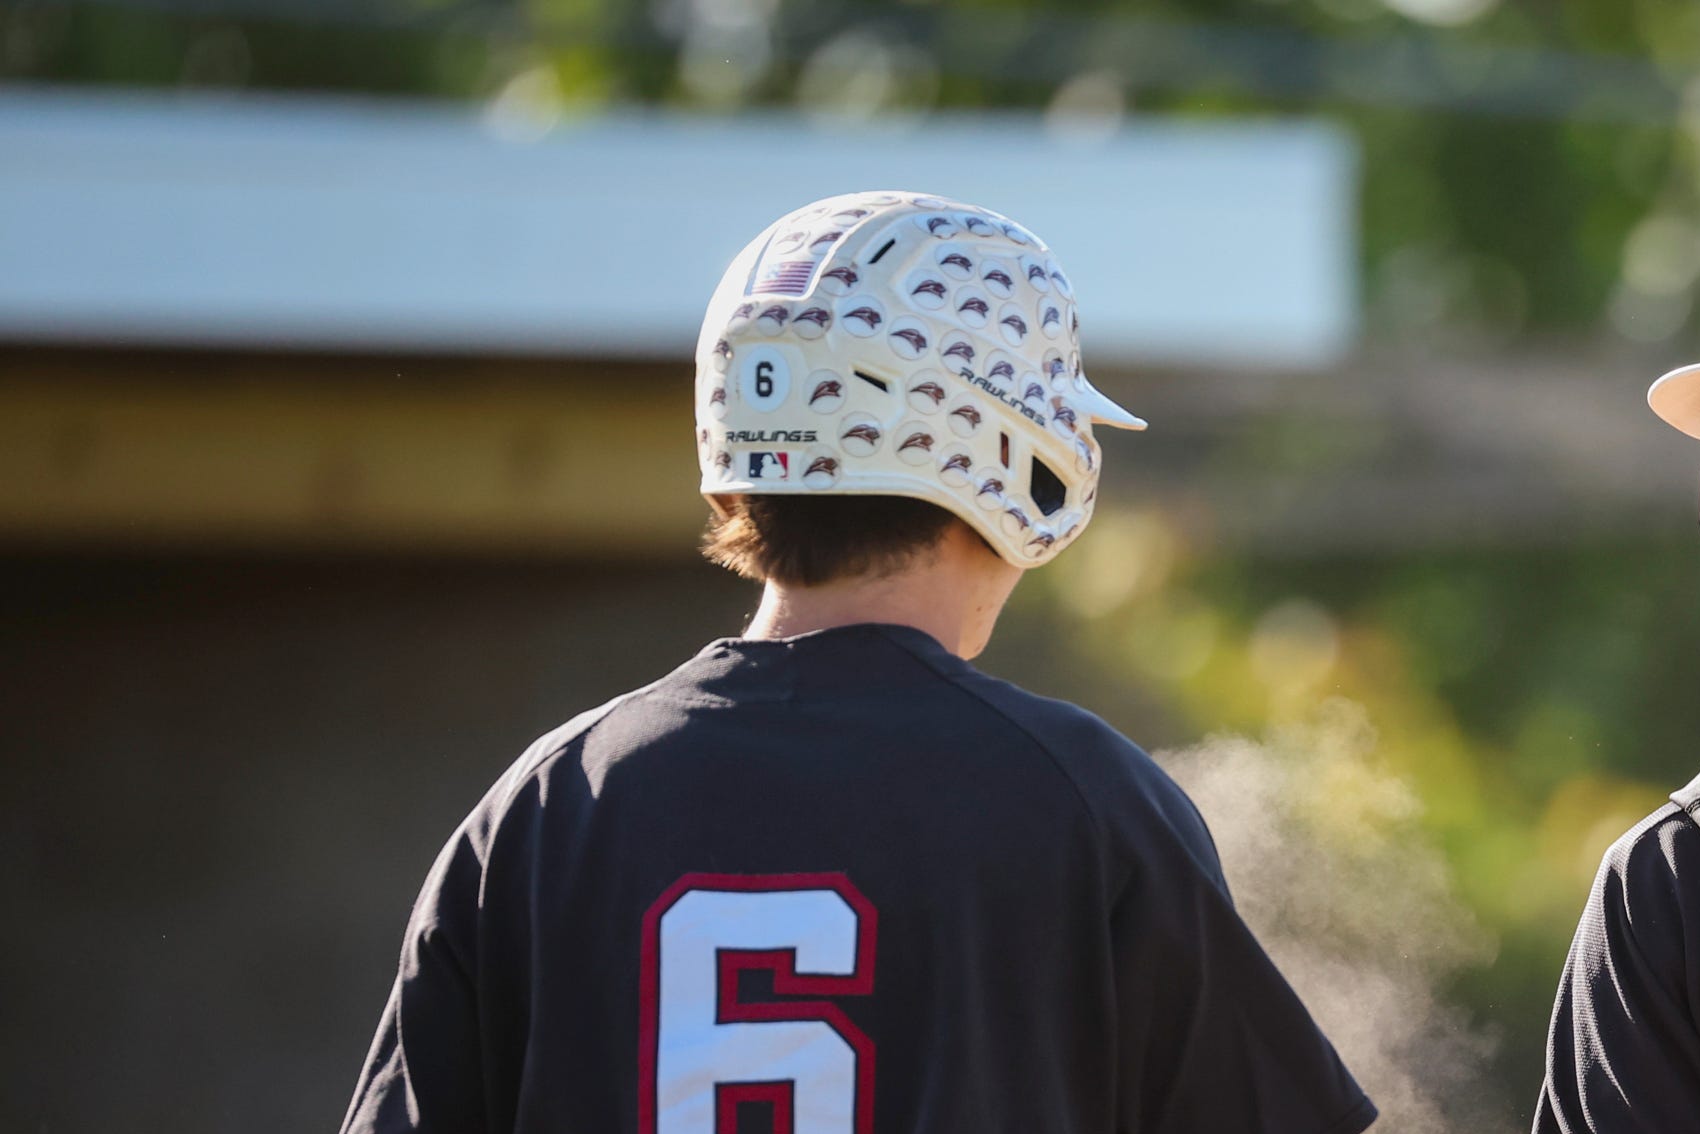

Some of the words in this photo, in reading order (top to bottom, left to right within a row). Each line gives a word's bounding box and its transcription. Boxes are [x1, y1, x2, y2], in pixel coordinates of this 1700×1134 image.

[755, 361, 774, 398] 6
[960, 366, 1046, 427] RAWLINGS
[725, 430, 818, 442] RAWLINGS
